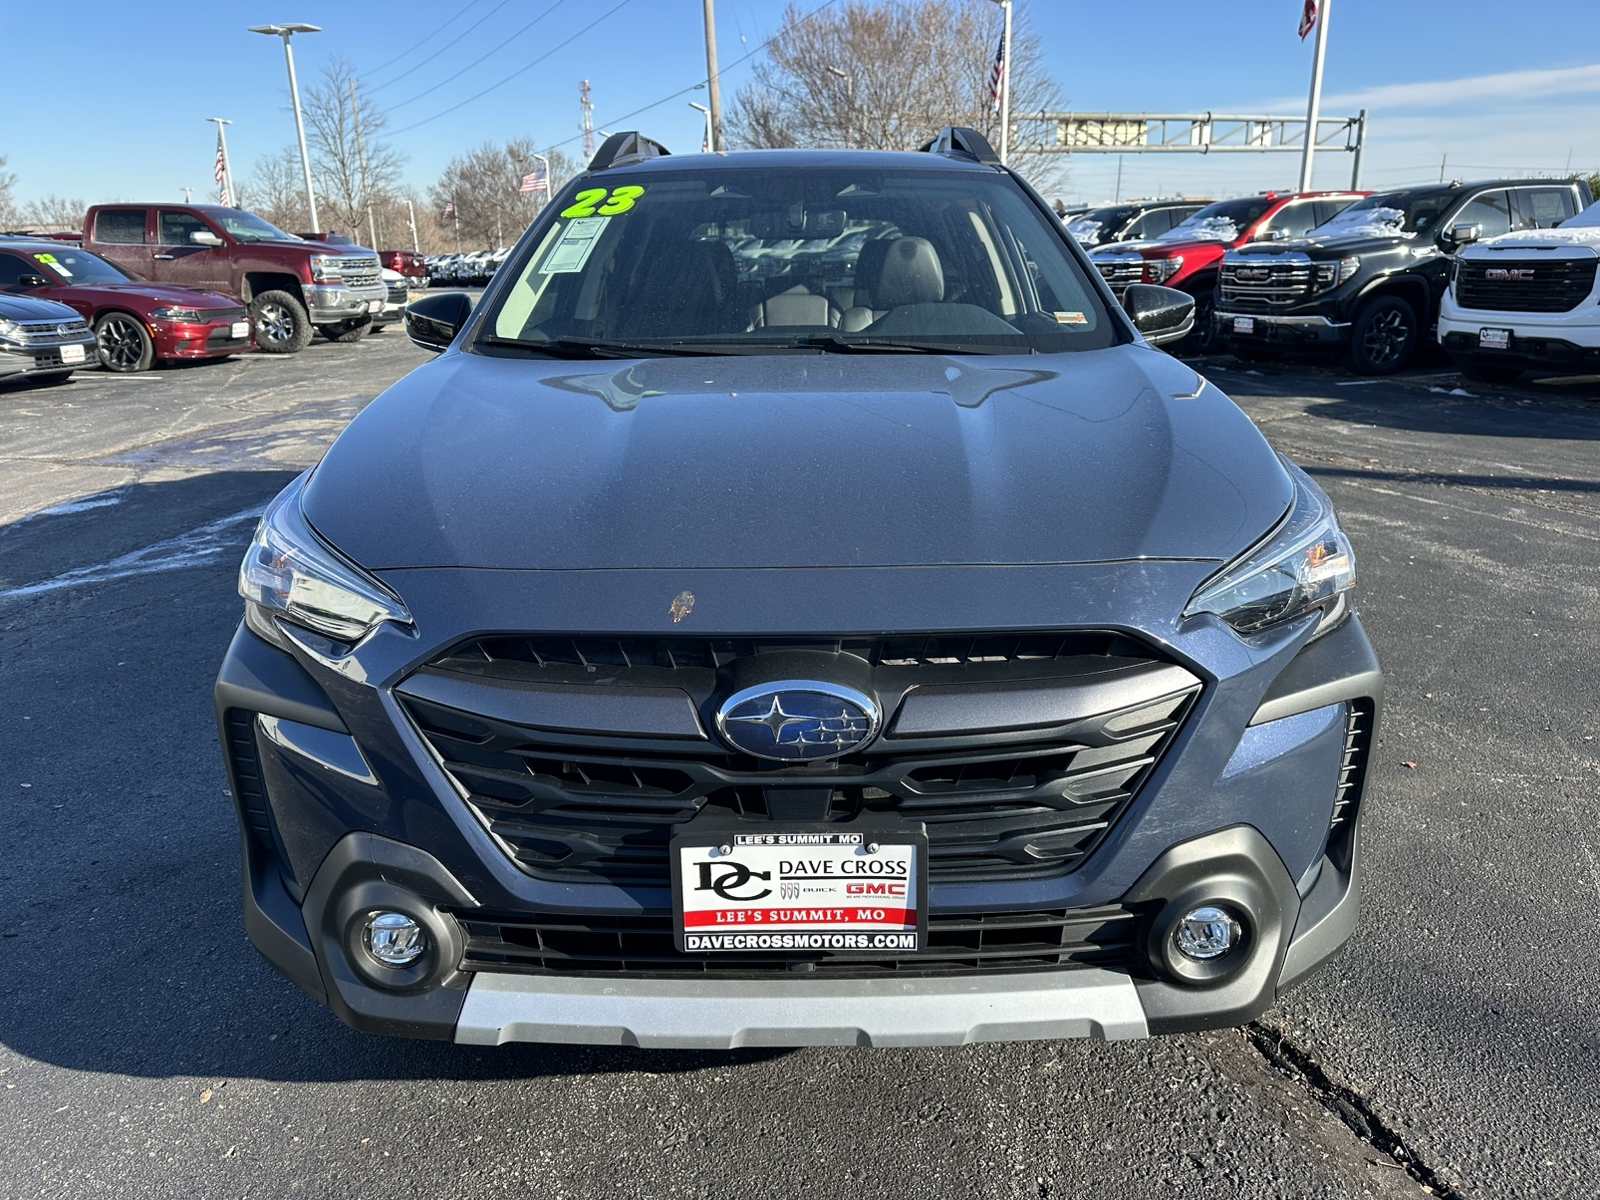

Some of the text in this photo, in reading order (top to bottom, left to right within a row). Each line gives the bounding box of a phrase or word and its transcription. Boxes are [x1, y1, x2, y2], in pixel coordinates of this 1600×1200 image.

[560, 185, 645, 218] 23
[1485, 268, 1535, 281] GMC
[737, 834, 861, 845] LEE'S SUMMIT MO
[779, 860, 907, 875] DAVE CROSS
[846, 883, 905, 895] GMC
[716, 910, 885, 923] LEE'S SUMMIT, MO
[688, 935, 914, 949] DAVECROSSMOTORS.COM
